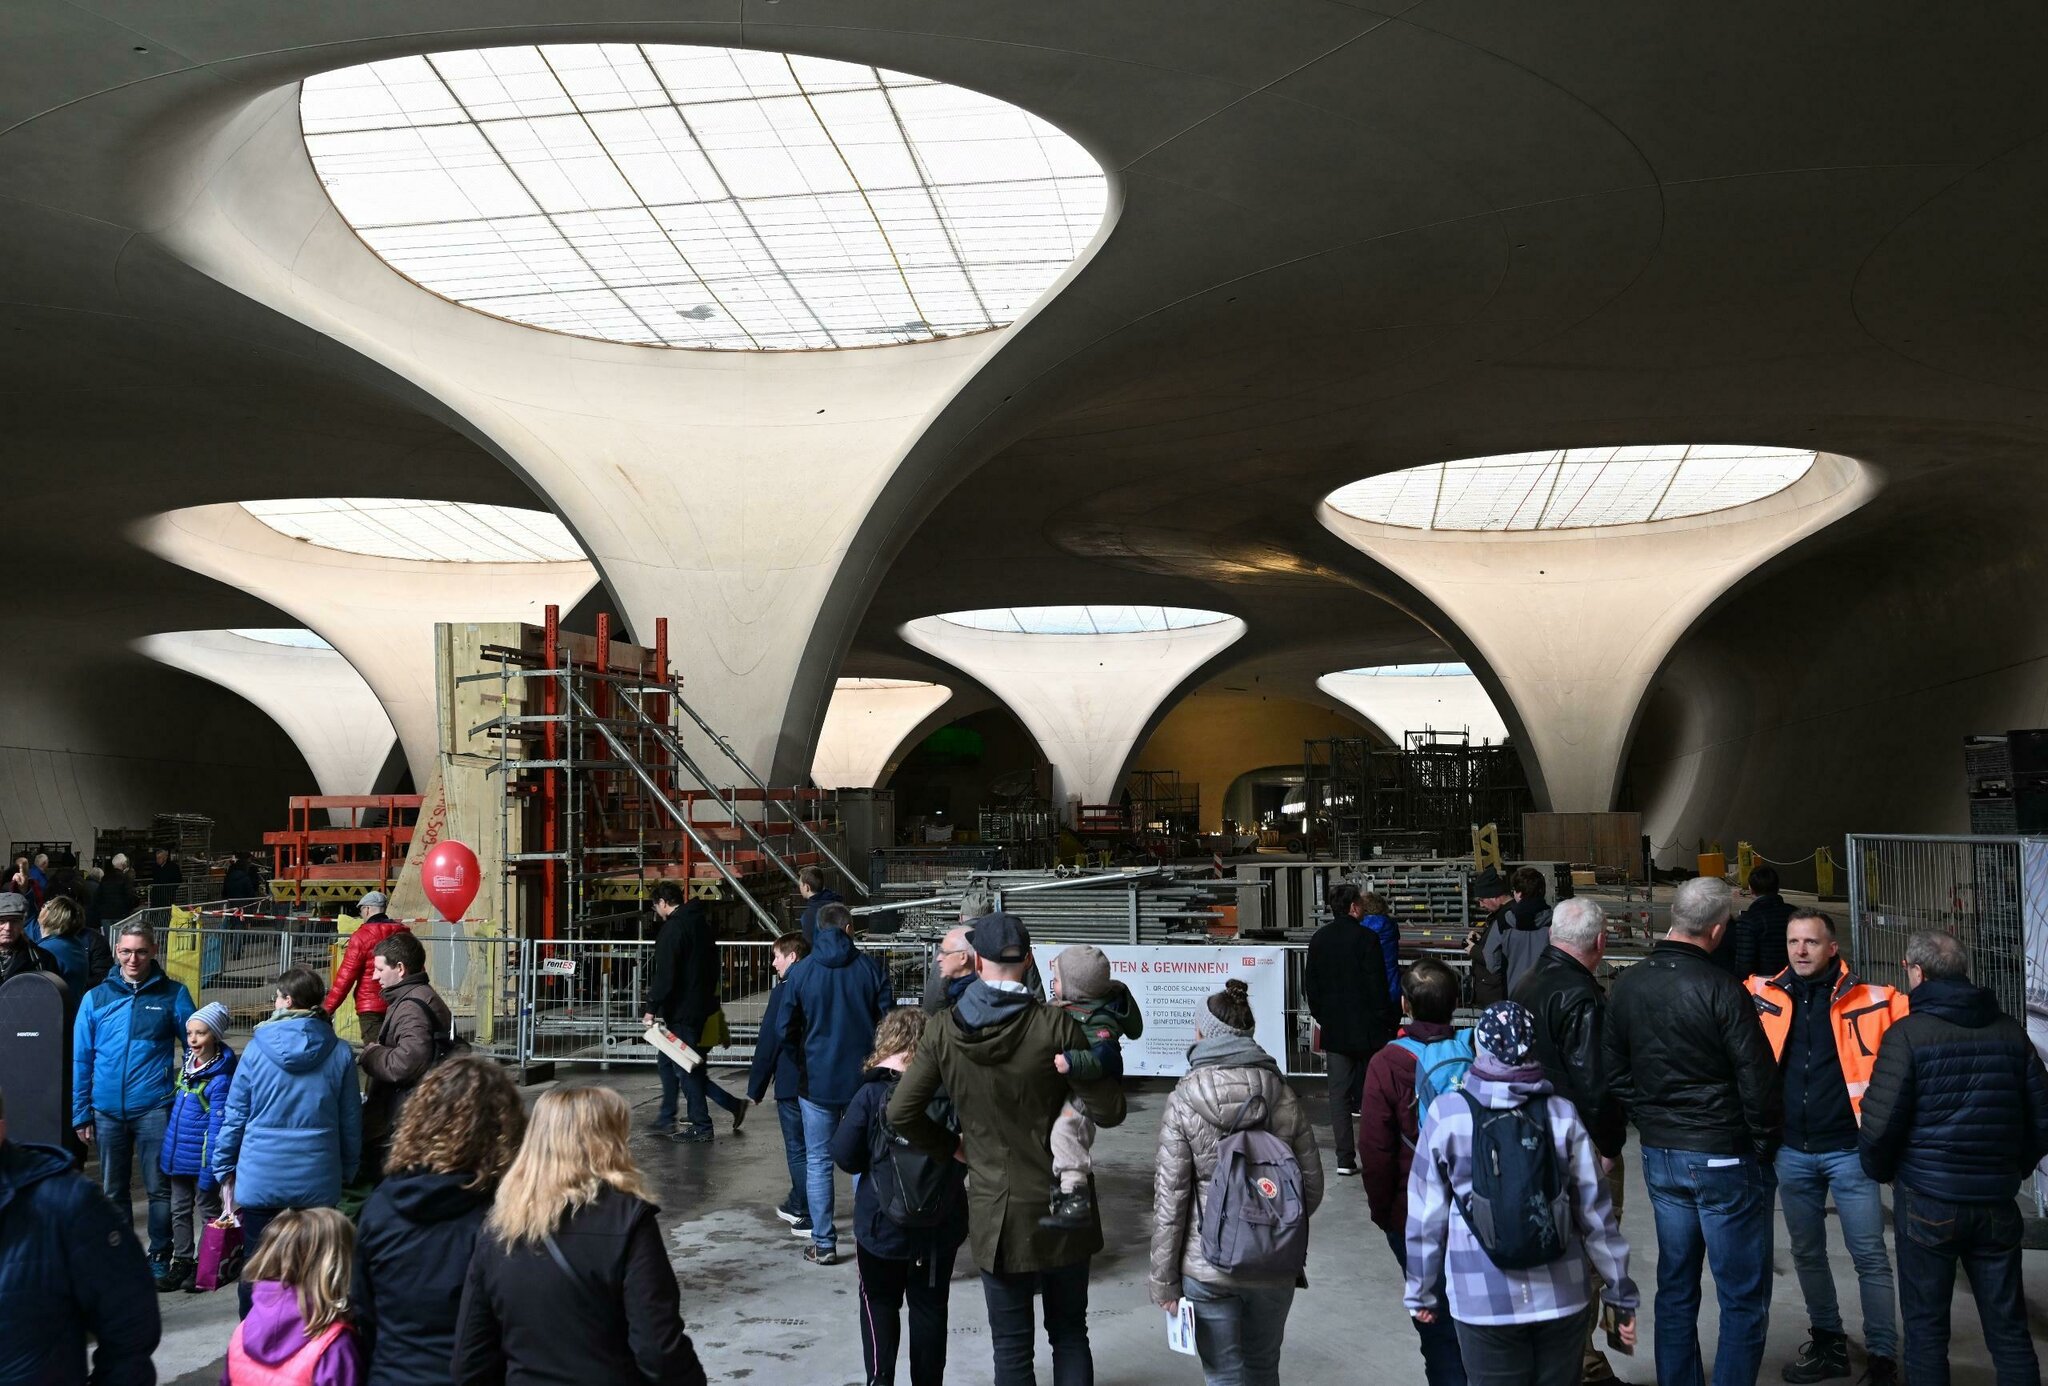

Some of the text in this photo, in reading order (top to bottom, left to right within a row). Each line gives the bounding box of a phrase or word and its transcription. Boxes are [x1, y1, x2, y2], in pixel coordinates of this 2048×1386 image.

[546, 961, 574, 970] rentES
[1242, 957, 1255, 966] ITS
[1111, 961, 1229, 974] TEN & GEWINNEN!
